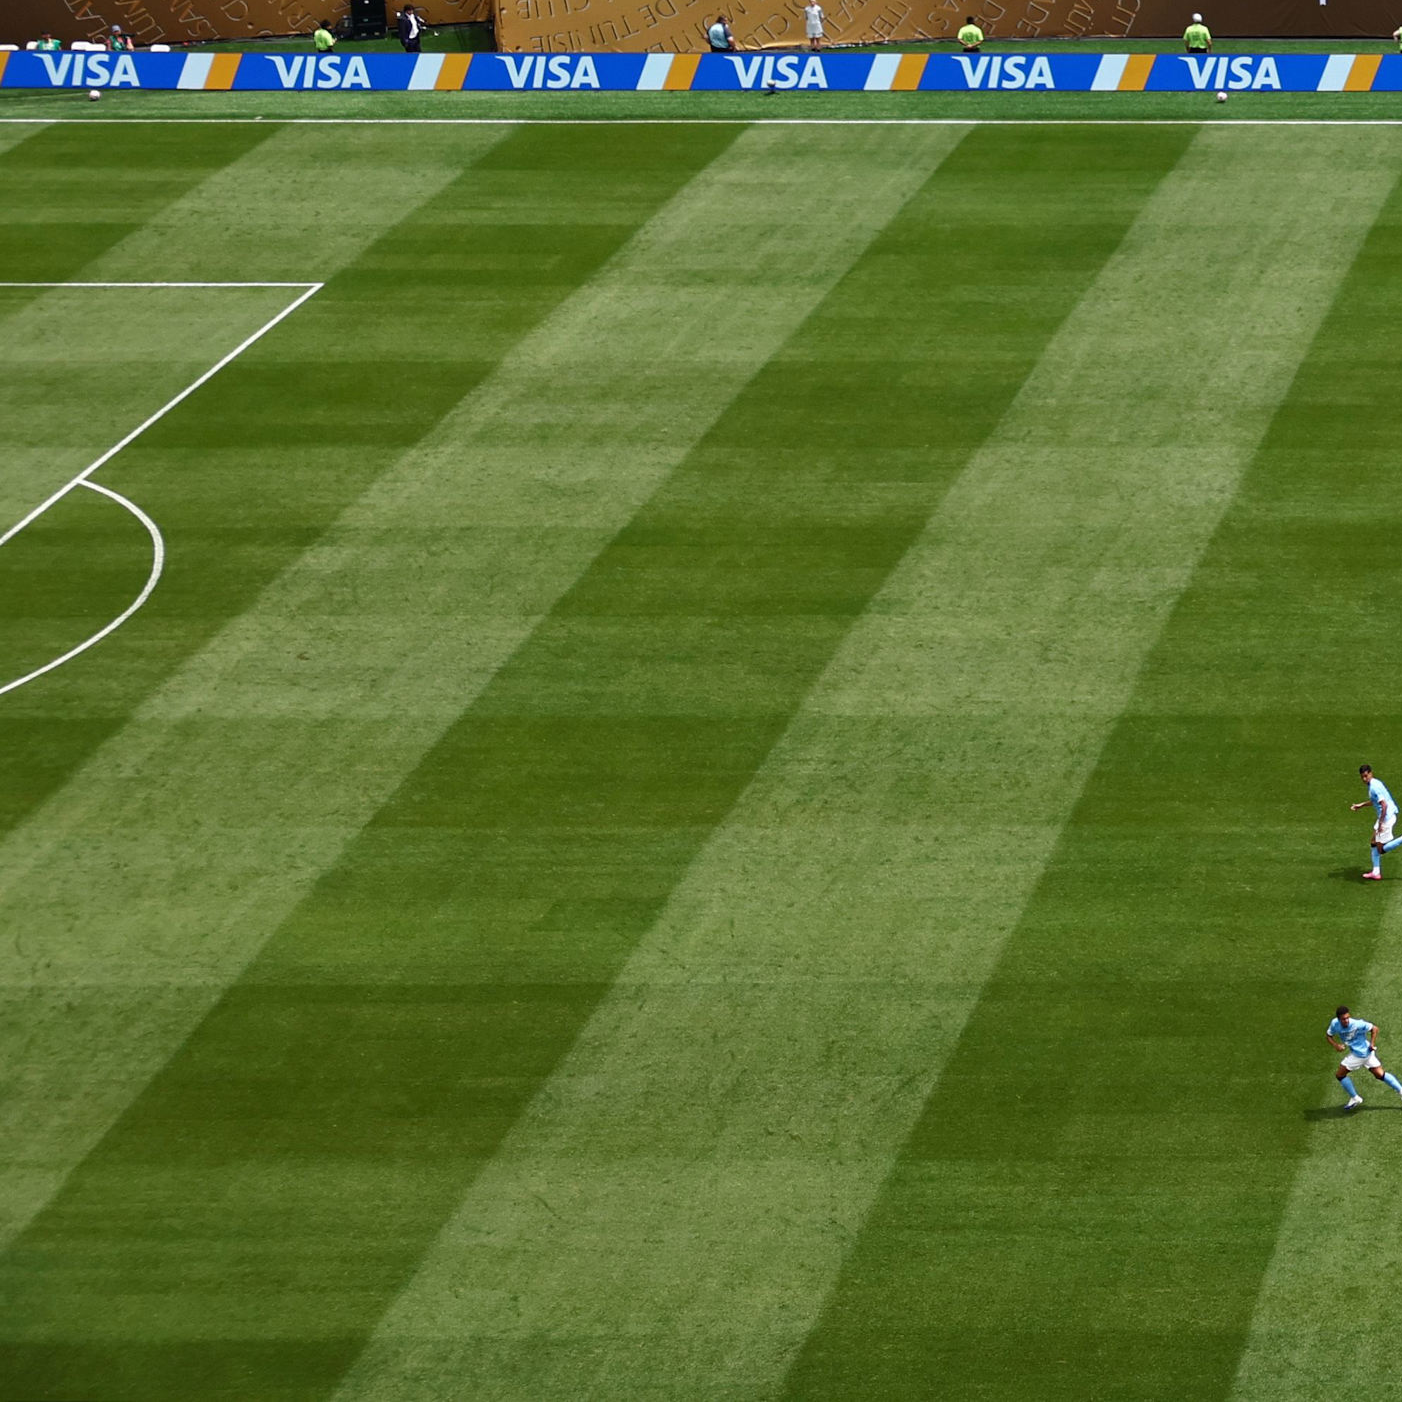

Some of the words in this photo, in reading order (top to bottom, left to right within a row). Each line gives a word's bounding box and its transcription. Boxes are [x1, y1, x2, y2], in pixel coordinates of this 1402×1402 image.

[35, 55, 140, 87] VISA
[265, 55, 371, 89] VISA
[495, 55, 600, 89] VISA
[724, 55, 828, 89] VISA
[951, 56, 1055, 89] VISA
[1179, 56, 1281, 90] VISA
